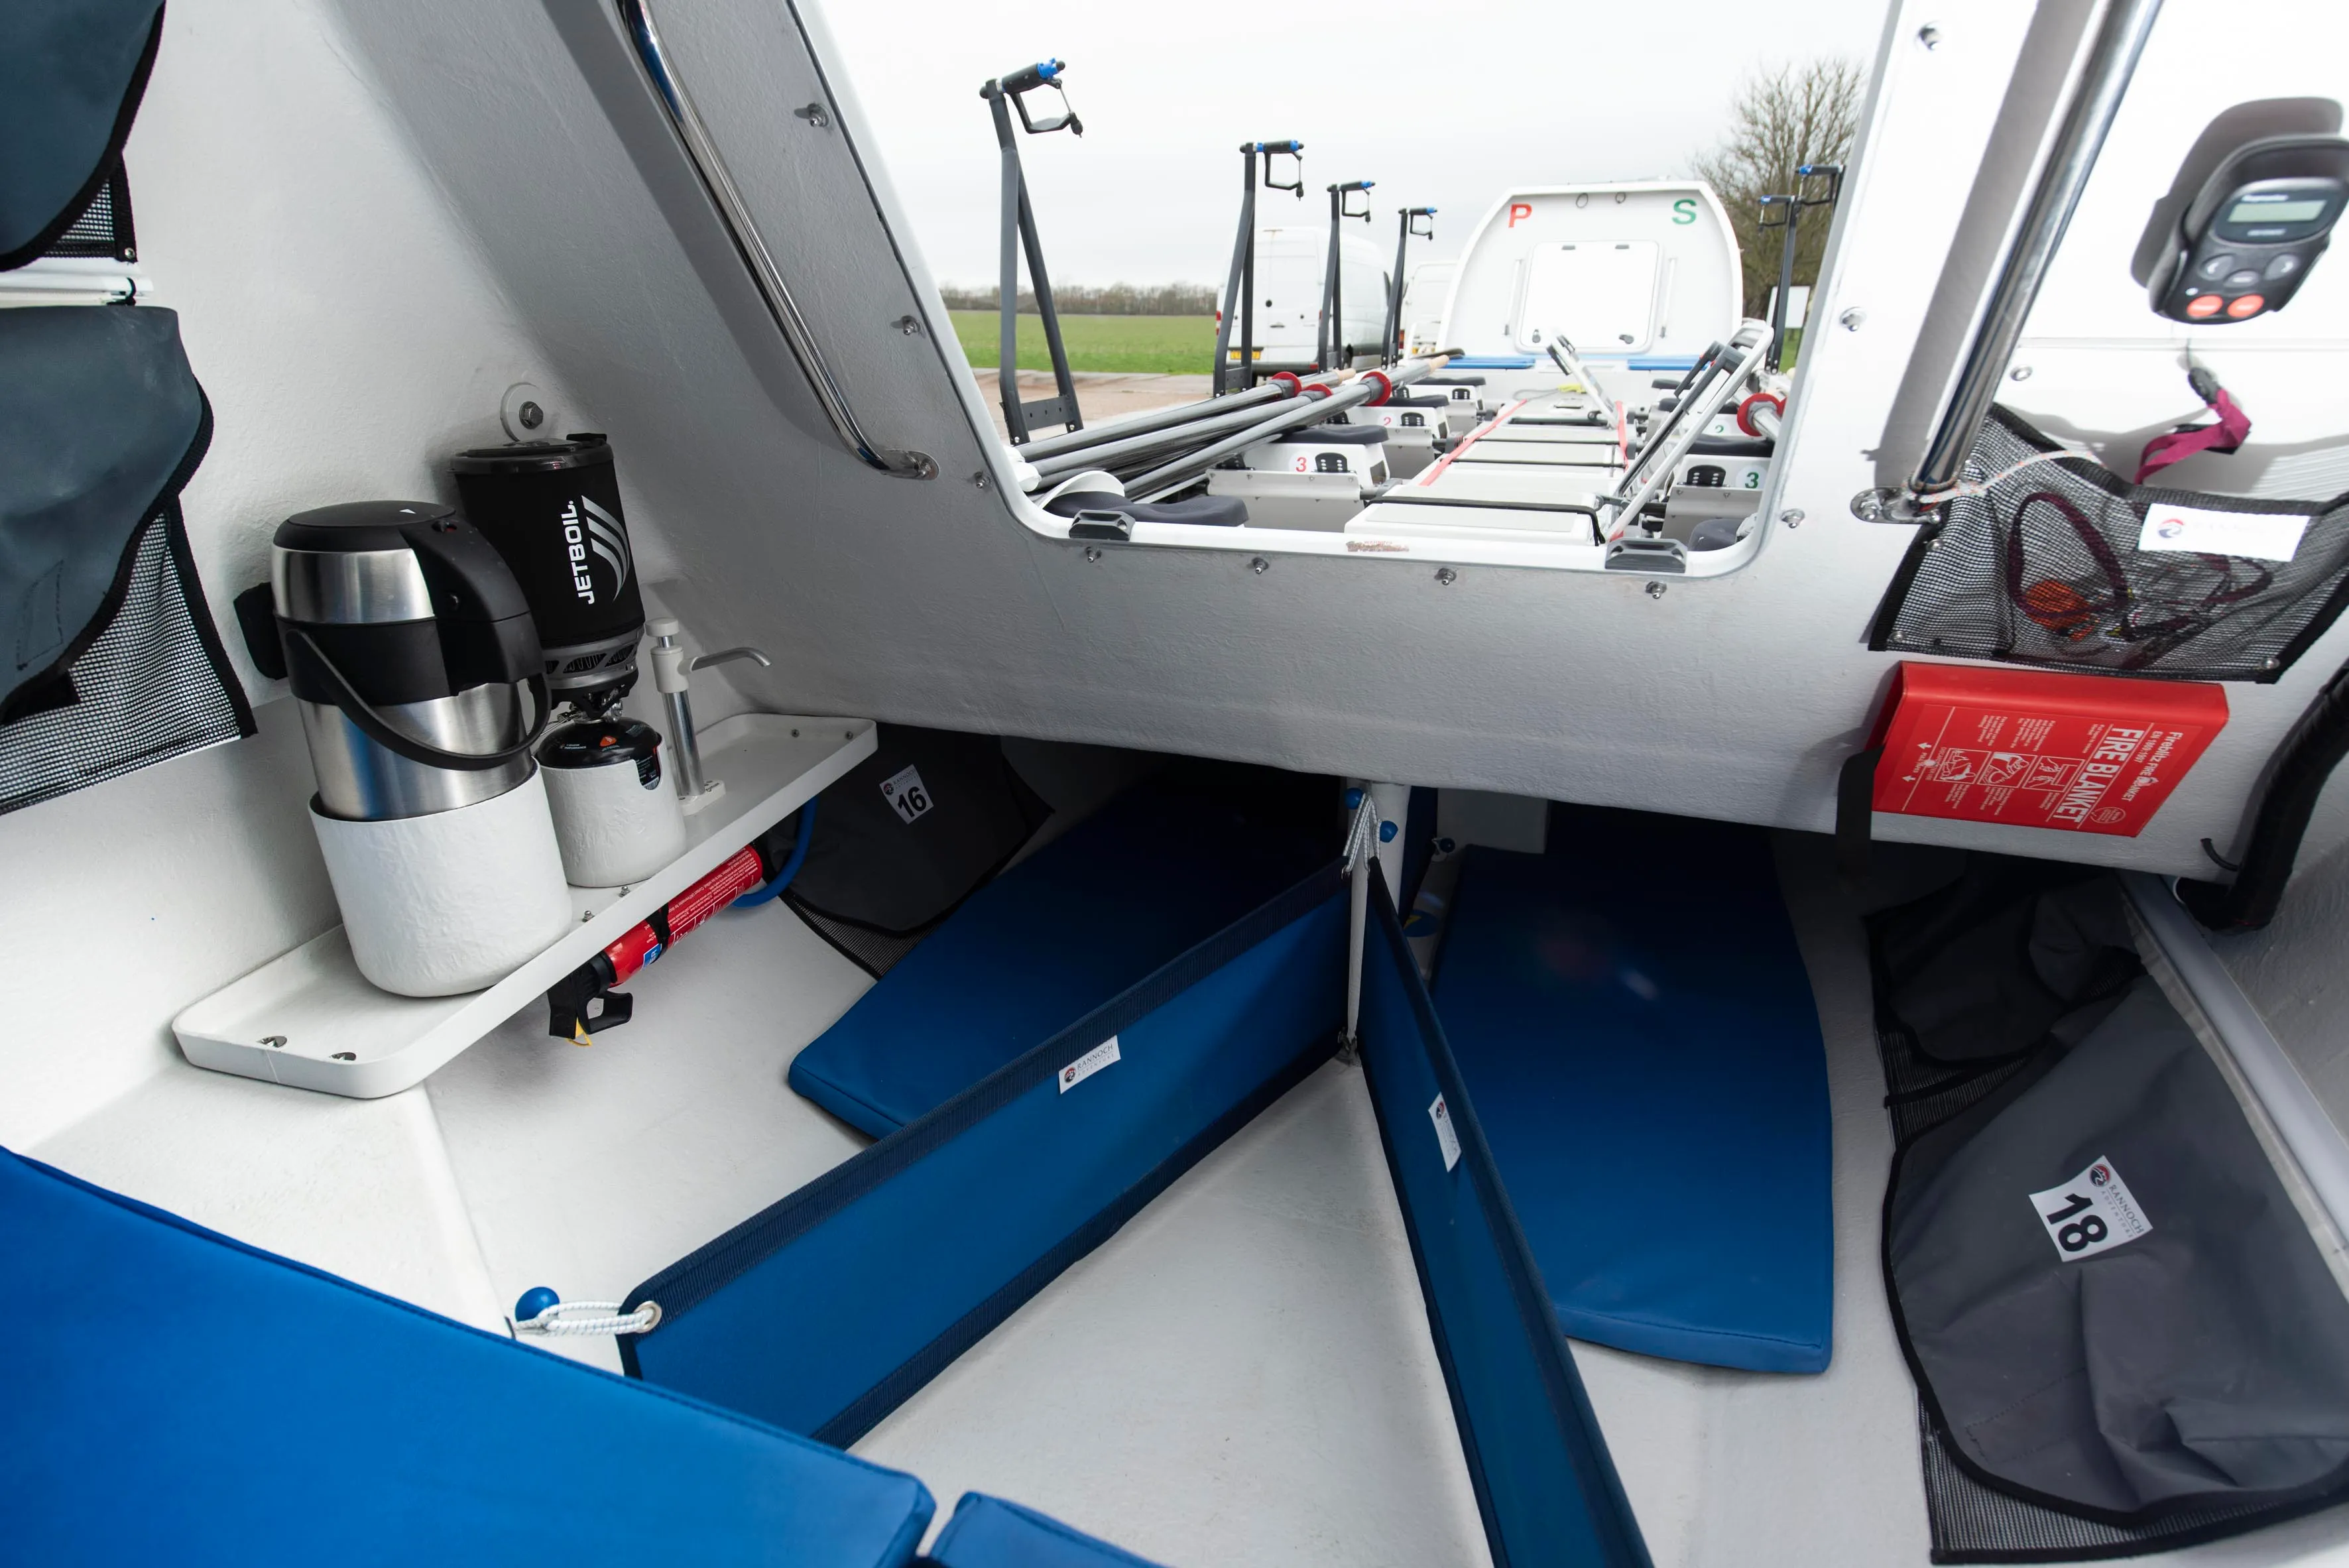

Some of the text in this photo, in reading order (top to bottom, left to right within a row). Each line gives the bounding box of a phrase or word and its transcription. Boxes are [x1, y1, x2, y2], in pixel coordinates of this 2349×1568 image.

[1508, 203, 1532, 228] P
[1672, 199, 1697, 225] S
[1383, 416, 1392, 426] 2
[1295, 456, 1307, 472] 3
[1744, 471, 1759, 489] 3
[560, 502, 595, 605] JETBOIL
[2092, 728, 2144, 760] FIRE
[2149, 731, 2184, 762] Fireblitz
[2138, 762, 2159, 776] FIRE
[898, 786, 927, 817] 16
[2052, 762, 2120, 822] BLANKET
[1077, 1044, 1113, 1069] RANNOCH
[2046, 1193, 2108, 1252] 18
[2109, 1184, 2144, 1234] RANNOCH
